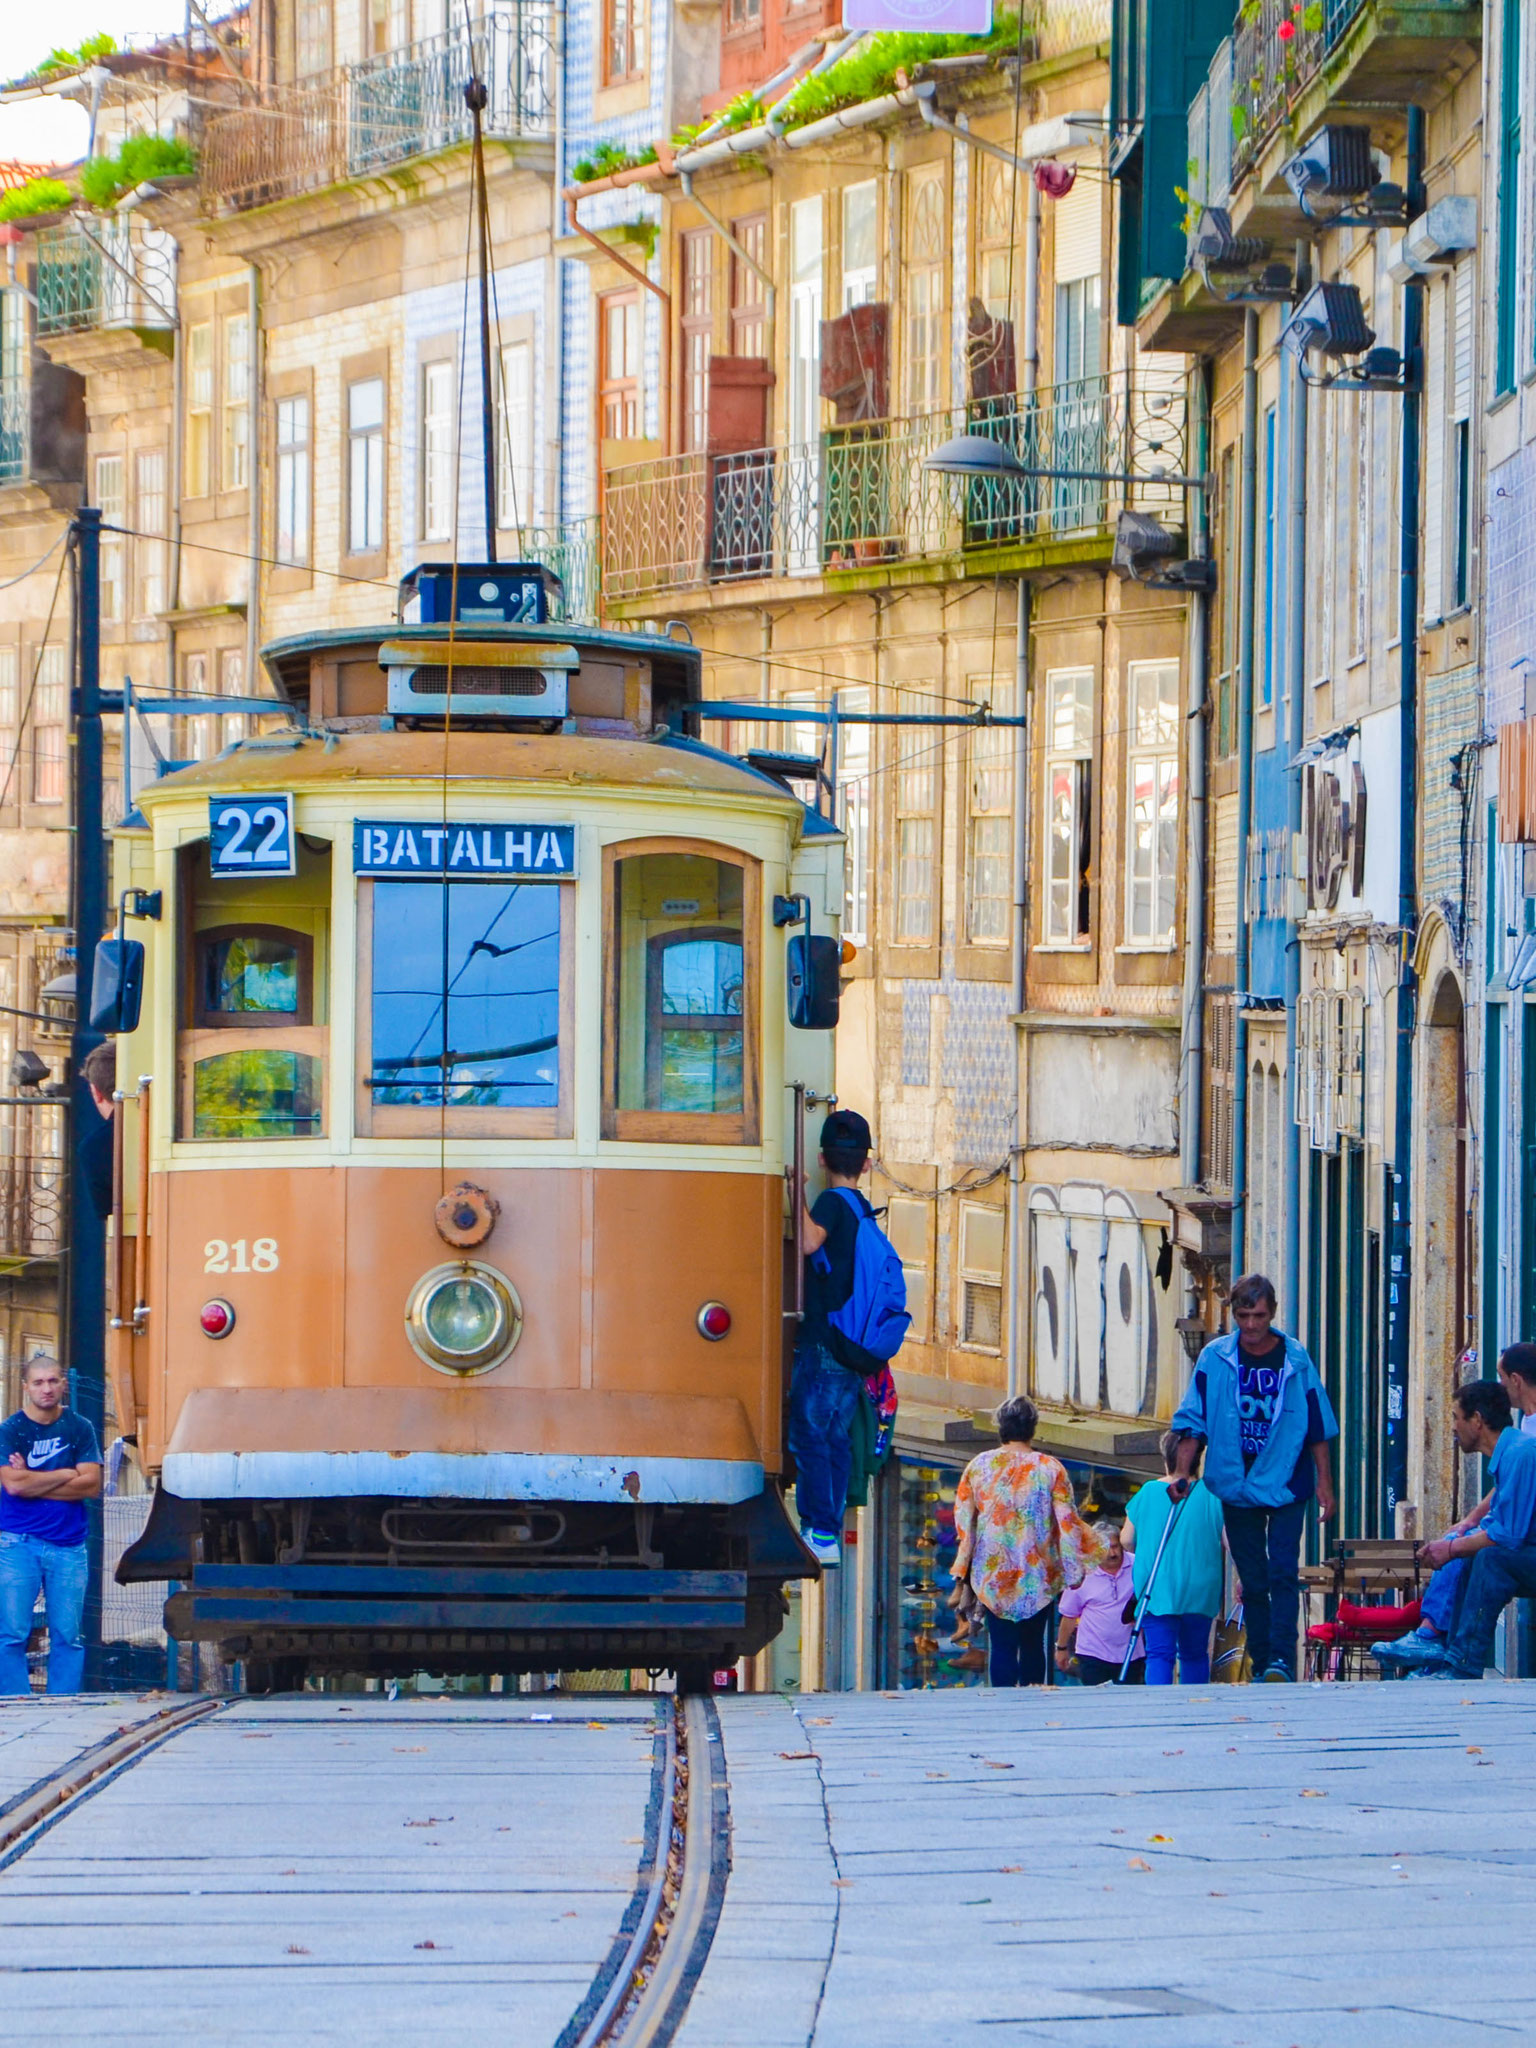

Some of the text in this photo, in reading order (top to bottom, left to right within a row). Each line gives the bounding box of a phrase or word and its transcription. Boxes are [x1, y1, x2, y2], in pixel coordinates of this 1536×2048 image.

[217, 806, 288, 864] 22
[362, 828, 565, 868] BATALHA
[203, 1237, 279, 1274] 218
[32, 1437, 61, 1456] NIKE
